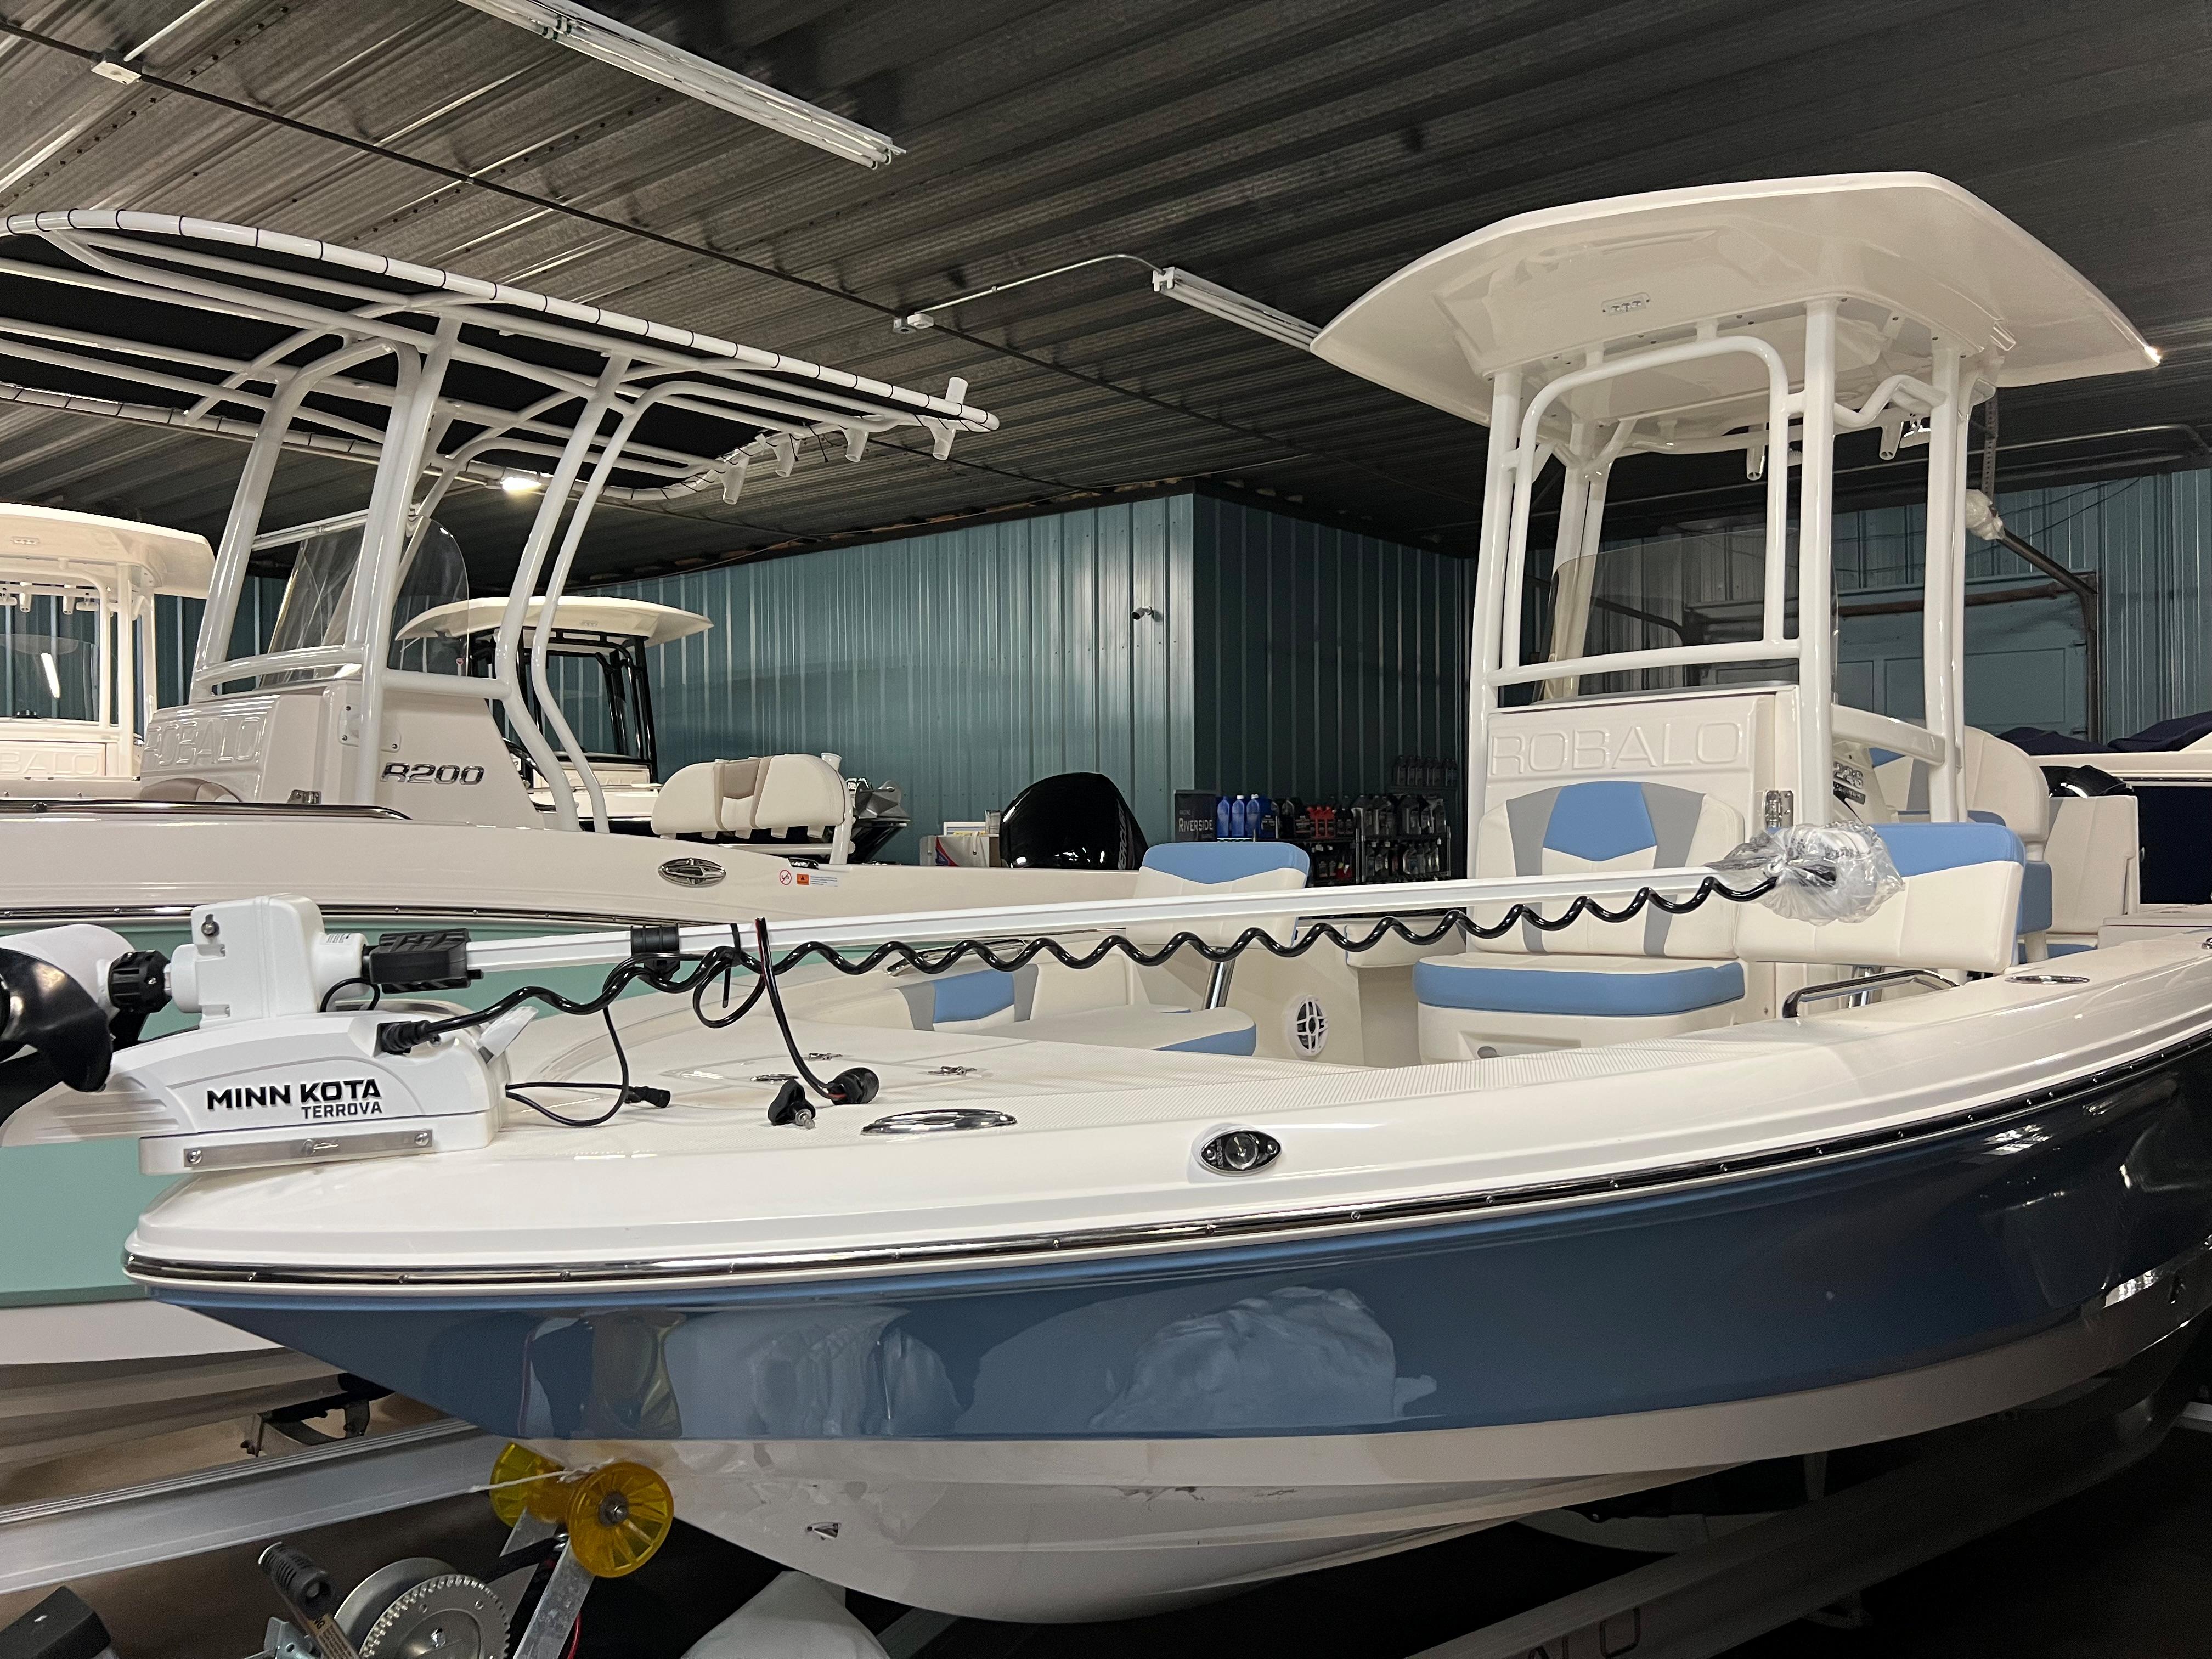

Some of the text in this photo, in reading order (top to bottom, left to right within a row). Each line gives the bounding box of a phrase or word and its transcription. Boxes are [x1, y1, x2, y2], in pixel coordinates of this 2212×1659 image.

[1491, 723, 1743, 775] ROBALO
[380, 762, 484, 785] R200
[207, 1079, 382, 1110] MINN KOTA
[301, 1101, 382, 1119] TERROVA
